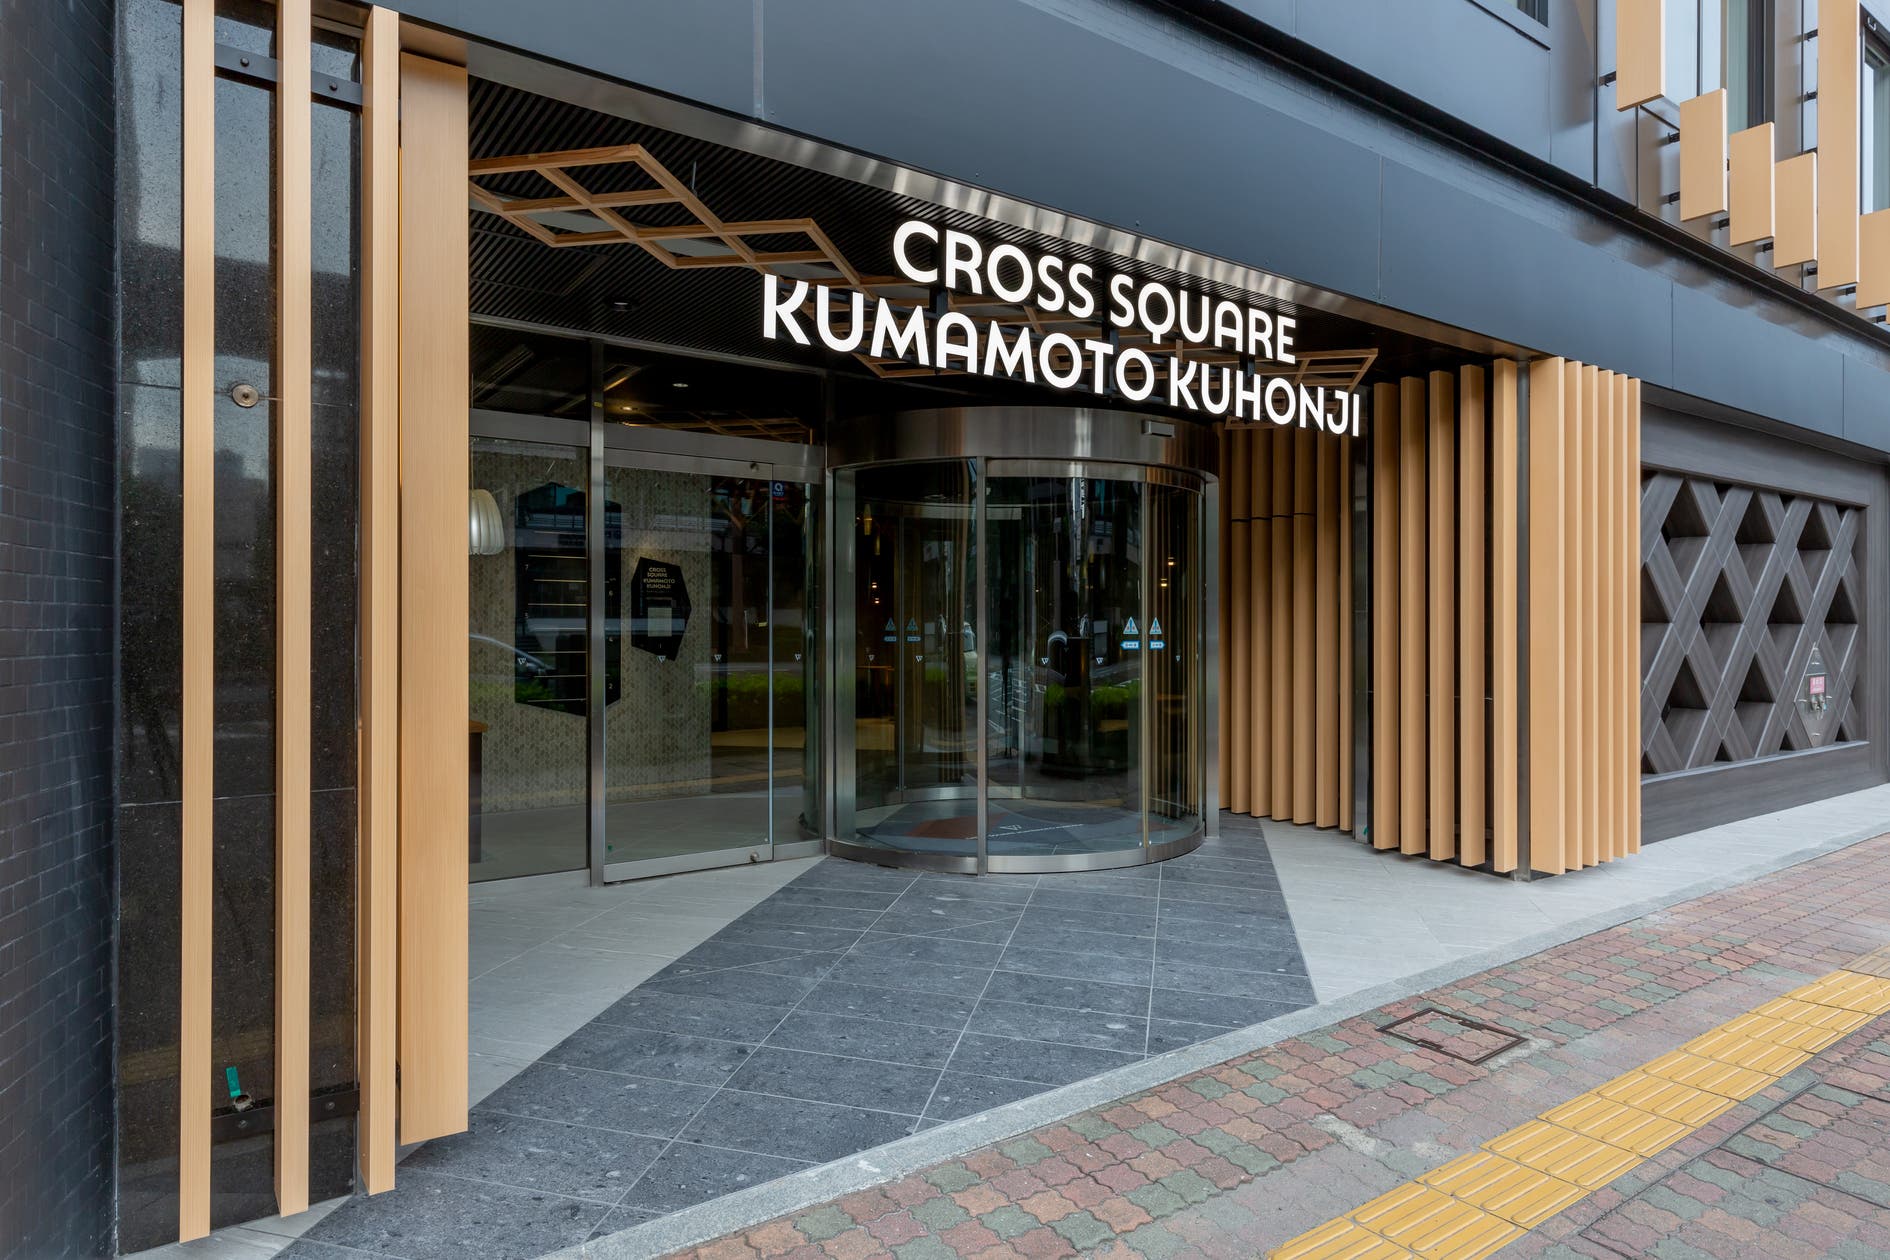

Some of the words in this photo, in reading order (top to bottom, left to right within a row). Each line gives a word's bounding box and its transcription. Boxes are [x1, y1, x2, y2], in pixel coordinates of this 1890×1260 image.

[763, 273, 1155, 401] KUMAMOTO
[1169, 356, 1361, 437] KUHONJI
[893, 220, 1095, 318] CROSS
[1109, 273, 1297, 364] SQUARE
